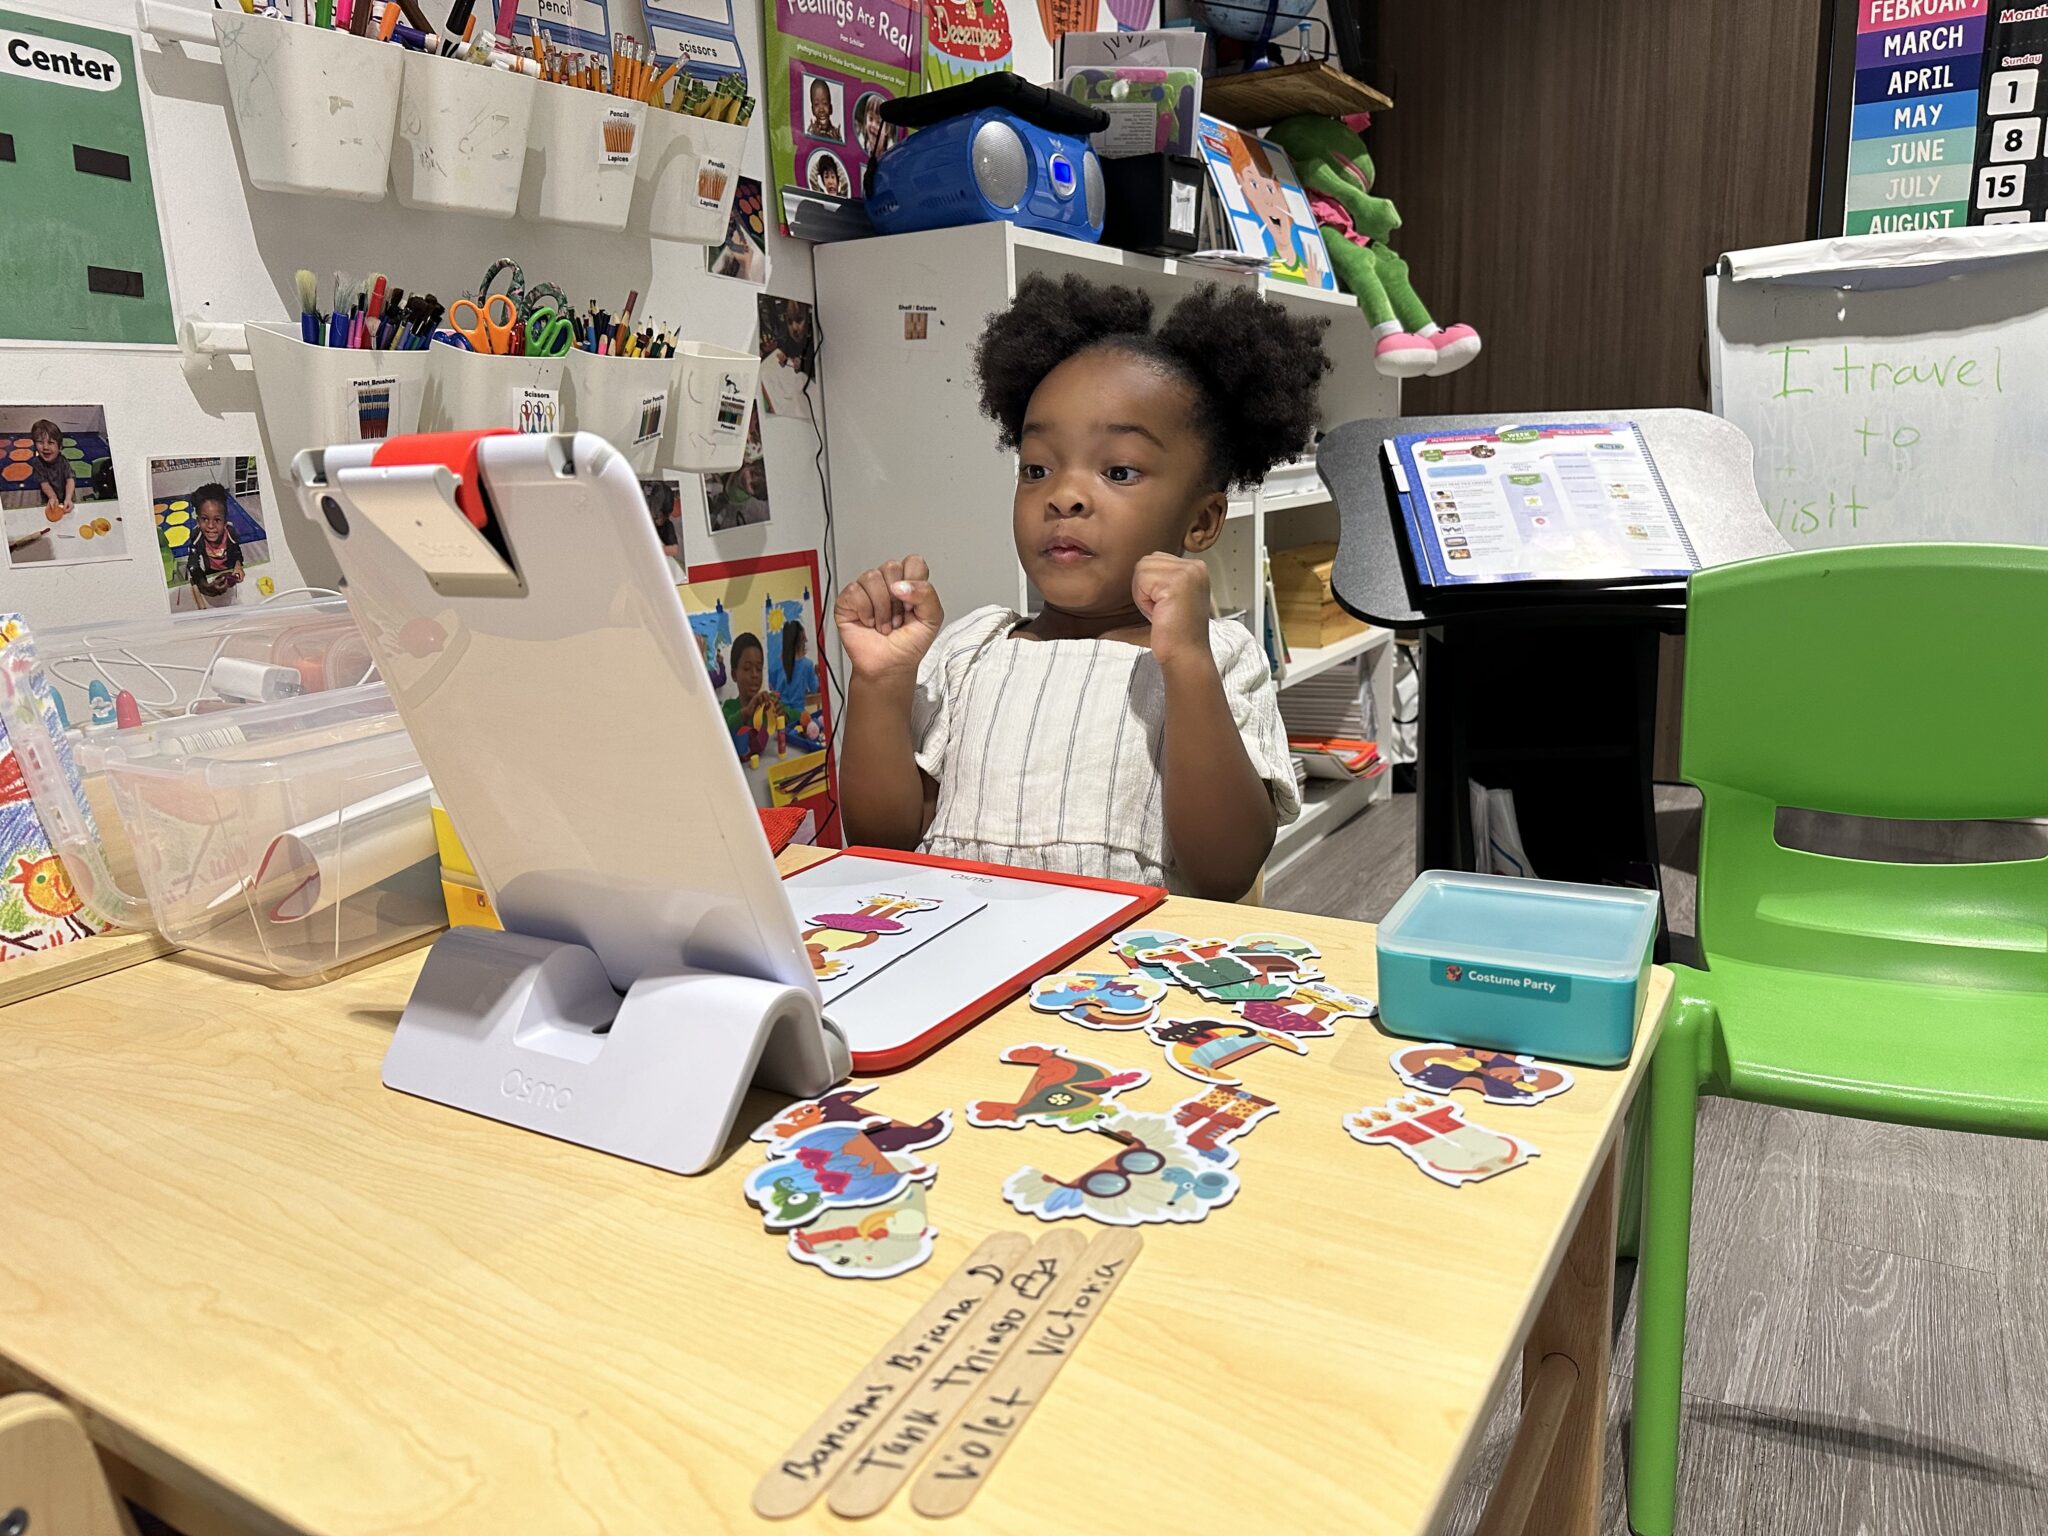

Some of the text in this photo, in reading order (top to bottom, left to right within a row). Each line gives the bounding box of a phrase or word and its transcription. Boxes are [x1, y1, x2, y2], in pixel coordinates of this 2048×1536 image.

[539, 0, 572, 16] pencil
[787, 0, 913, 58] Feelings Are Real
[934, 5, 1000, 57] December
[1884, 24, 1963, 58] MARCH
[8, 38, 115, 82] Center
[679, 40, 718, 57] scissors
[2001, 53, 2043, 67] Sunday
[1887, 65, 1954, 95] APRIL
[2008, 80, 2018, 104] 1
[610, 110, 629, 118] Pencils
[1894, 103, 1943, 130] MAY
[1887, 138, 1945, 165] JUNE
[2004, 128, 2023, 152] 8
[1885, 174, 1942, 200] JULY
[1985, 174, 2017, 199] 15
[1869, 209, 1955, 235] AUGUST
[372, 378, 396, 386] Brushes
[1768, 345, 2002, 398] I travel
[524, 390, 550, 399] Scissors
[1854, 416, 1921, 457] to
[950, 873, 993, 884] Osmo
[1468, 970, 1556, 993] Costume Party
[500, 1068, 574, 1112] Osmo
